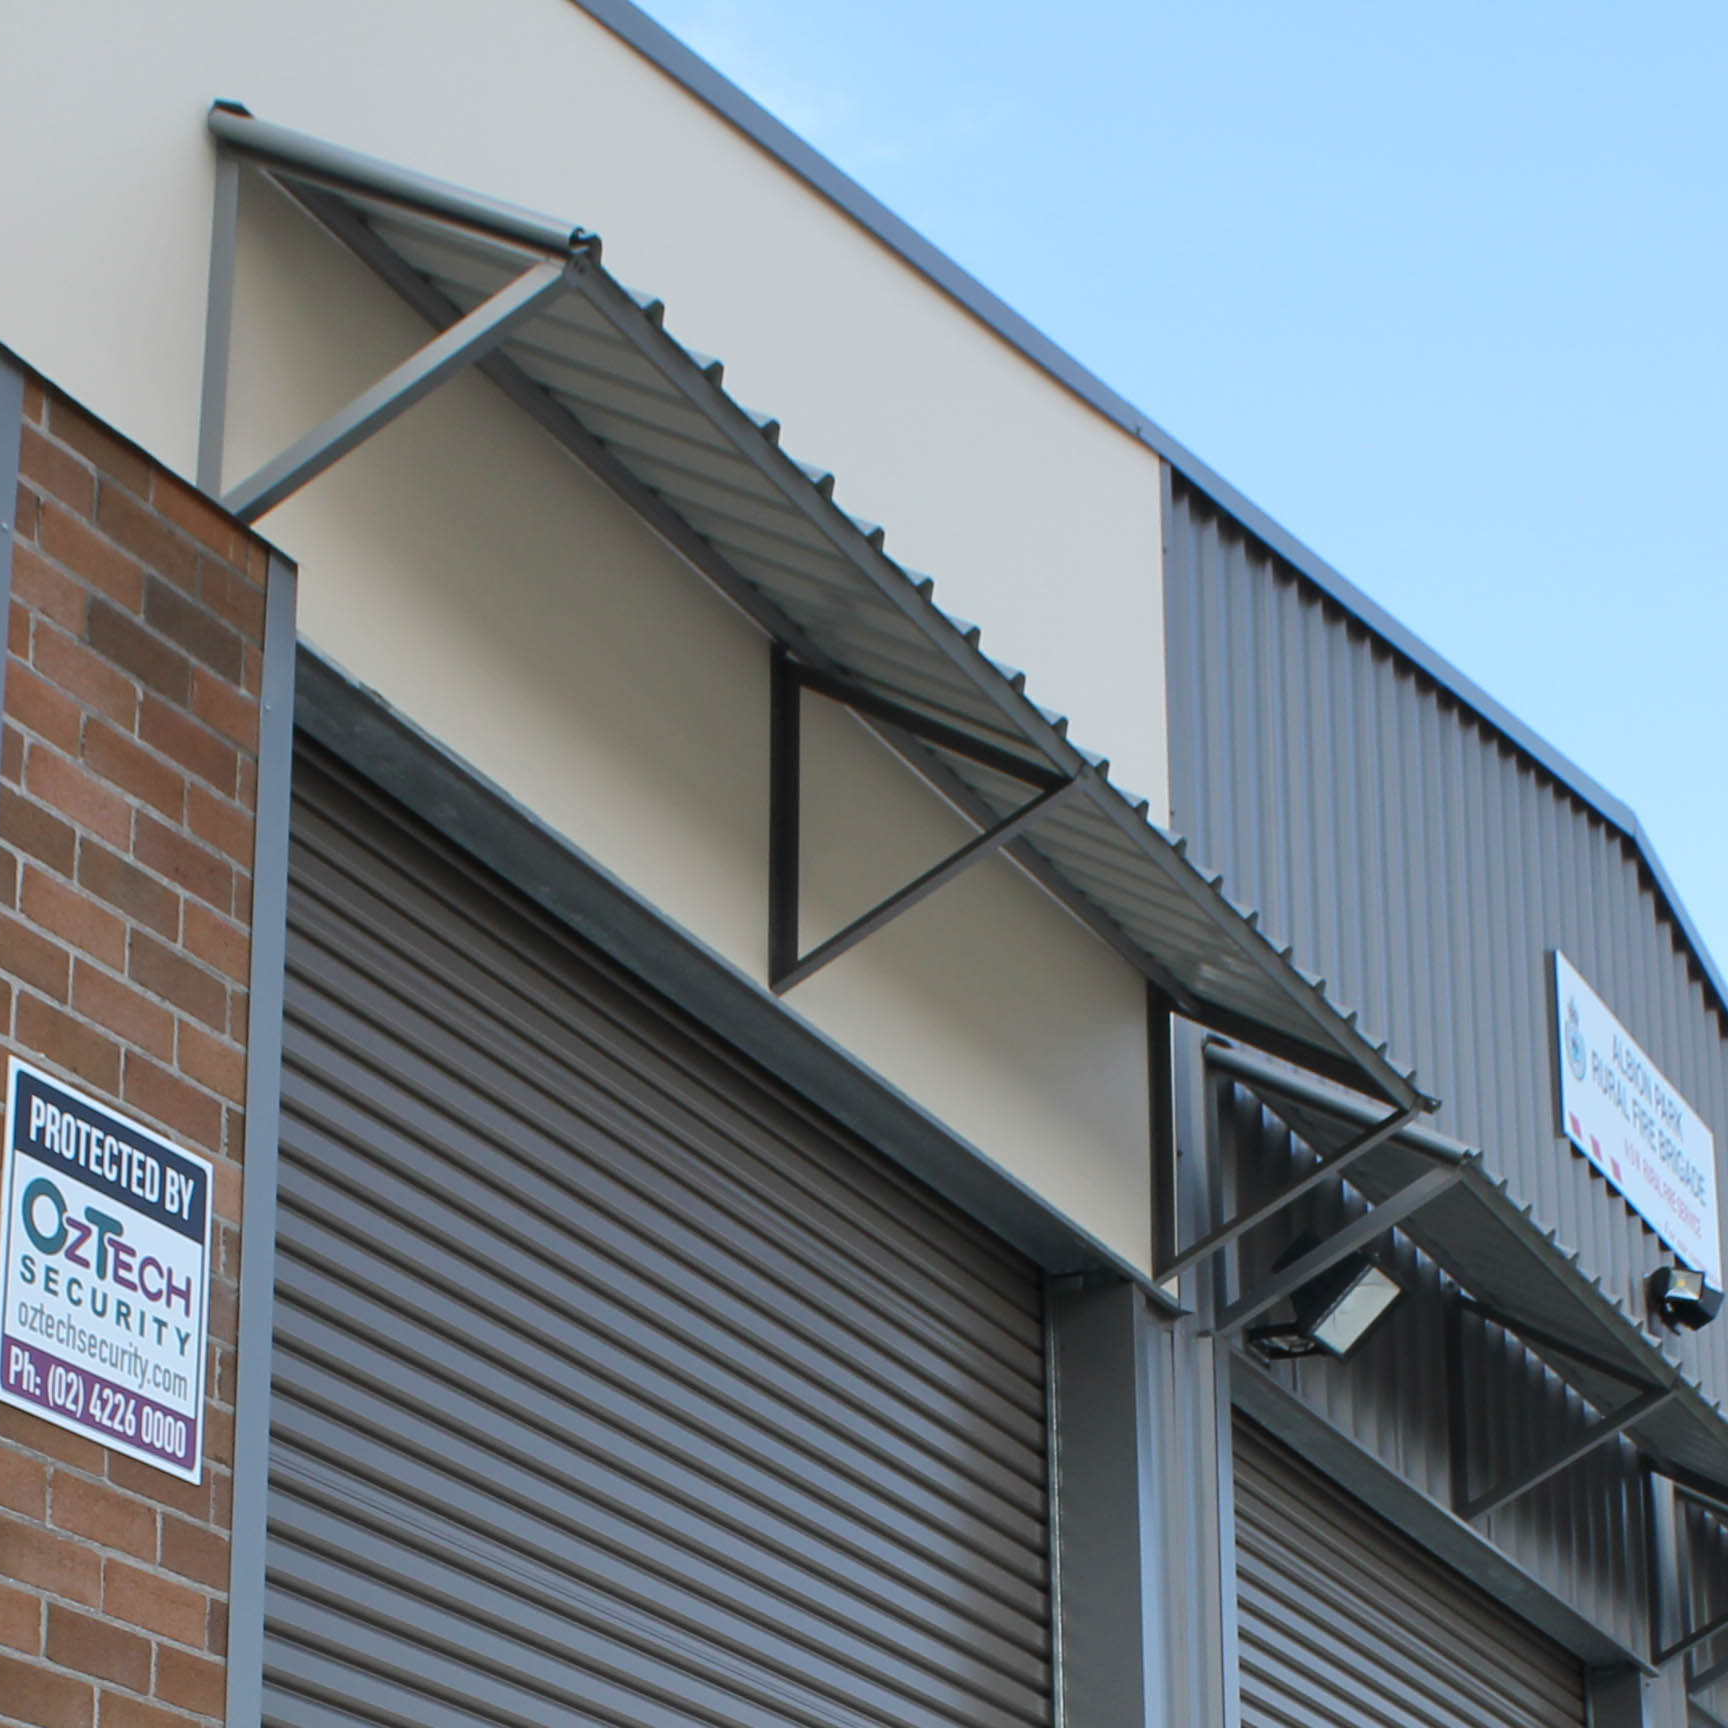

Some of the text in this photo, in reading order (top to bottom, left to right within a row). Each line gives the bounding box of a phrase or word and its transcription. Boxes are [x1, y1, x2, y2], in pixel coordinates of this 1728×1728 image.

[28, 1094, 195, 1221] PROTECTED BY
[1591, 1049, 1630, 1121] RURAL
[1632, 1099, 1657, 1152] FIRE
[1658, 1128, 1706, 1207] BRIGADE
[1654, 1082, 1683, 1142] PARK
[18, 1301, 188, 1401] oztechsecurity.com
[20, 1254, 191, 1357] SECURITY
[8, 1344, 187, 1459] Ph: (02) 4226 0000
